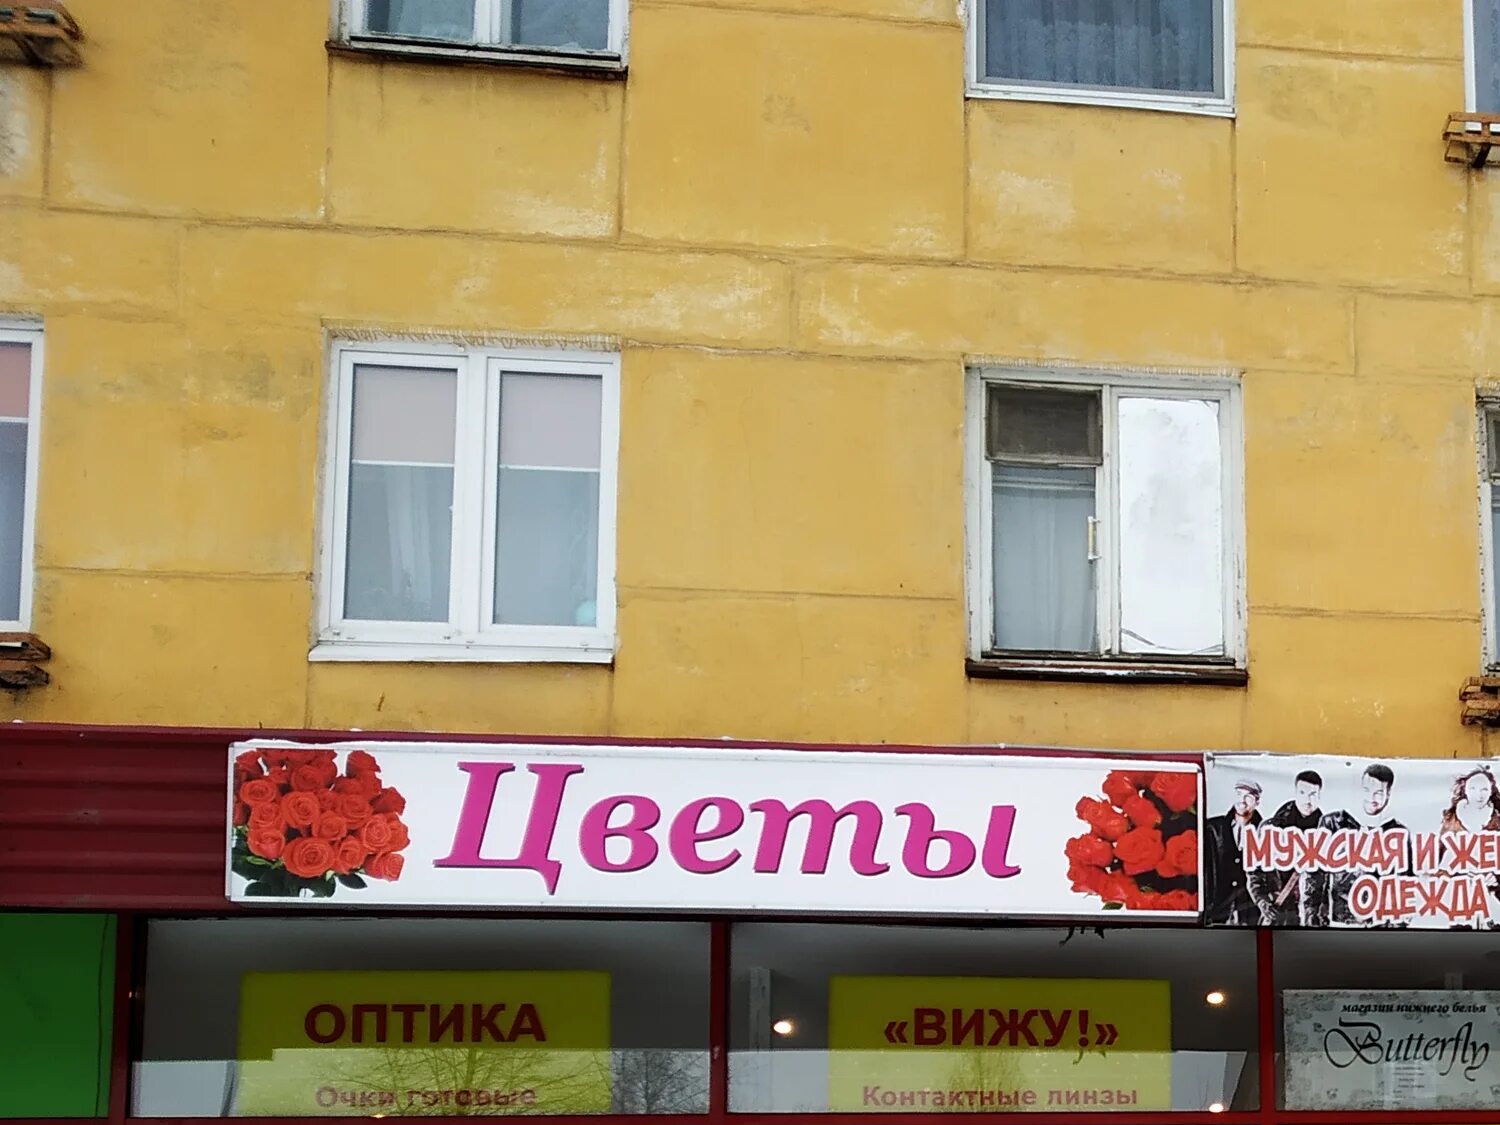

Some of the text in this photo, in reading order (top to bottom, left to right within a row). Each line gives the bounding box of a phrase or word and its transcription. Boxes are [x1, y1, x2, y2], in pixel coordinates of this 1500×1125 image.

[433, 761, 1022, 896] Цветы
[1245, 828, 1410, 871] МУЖСКАЯ
[1415, 833, 1437, 871] И
[1350, 877, 1490, 921] ОДЕЖДА
[304, 1002, 547, 1044] ОПТИКА
[884, 1007, 1119, 1048] «ВИЖУ!»
[1341, 1001, 1487, 1014] магазин нижнего белья
[1323, 1016, 1490, 1082] Butterfly
[315, 1086, 537, 1109] Очки готовые
[862, 1085, 1138, 1107] Контактные линзы
